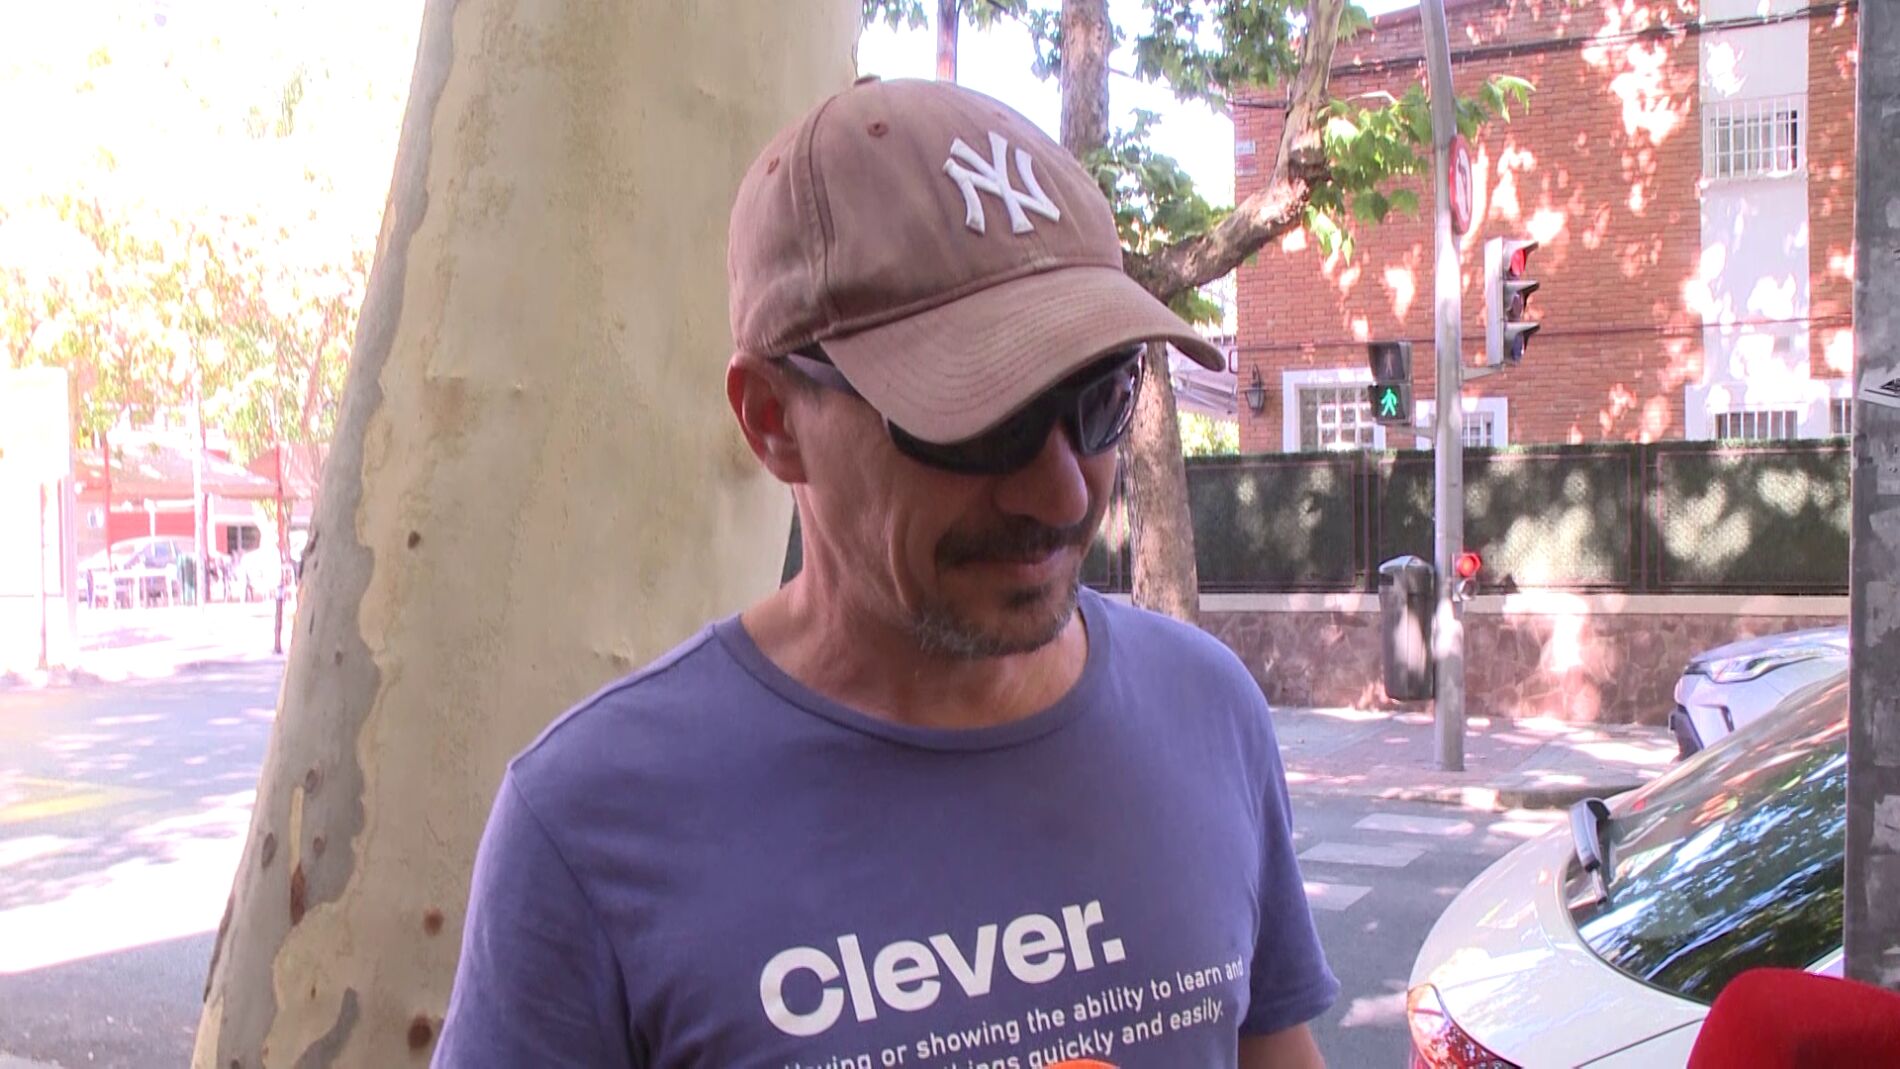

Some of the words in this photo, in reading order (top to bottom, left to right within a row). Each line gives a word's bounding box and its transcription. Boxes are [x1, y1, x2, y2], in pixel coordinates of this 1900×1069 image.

[943, 131, 1061, 235] NY
[760, 900, 1126, 1037] Clever.
[785, 1054, 872, 1069] ing
[881, 1045, 907, 1066] or
[916, 1021, 1020, 1059] showing
[1027, 1008, 1066, 1033] the
[1073, 987, 1144, 1020] ability
[1150, 978, 1172, 1000] to
[1176, 966, 1222, 993] learn
[1225, 955, 1244, 980] and
[1028, 1029, 1114, 1069] quickly
[1121, 1012, 1163, 1044] and
[1169, 997, 1224, 1031] easily.
